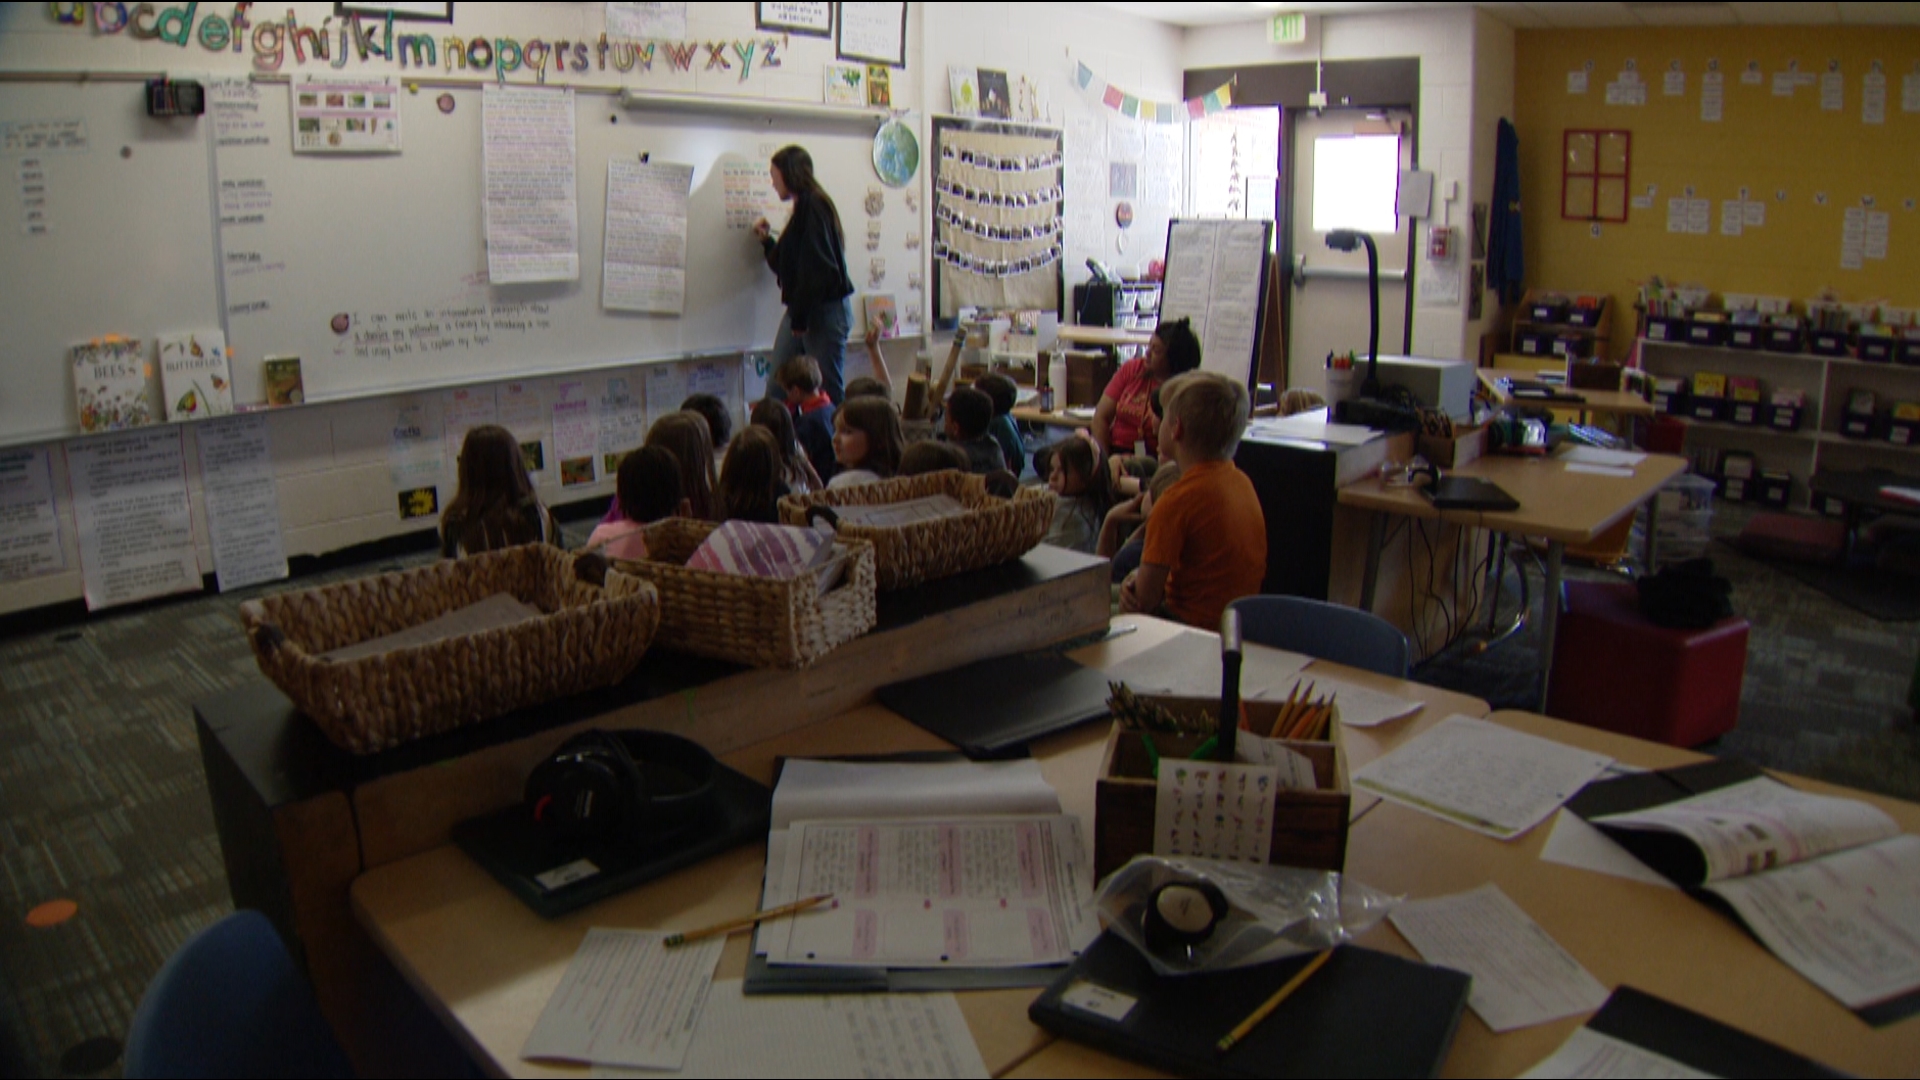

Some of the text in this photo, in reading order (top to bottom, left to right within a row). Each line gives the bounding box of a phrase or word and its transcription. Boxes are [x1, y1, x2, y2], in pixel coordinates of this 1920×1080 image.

[1273, 14, 1302, 40] EXIT
[94, 364, 125, 380] BEES
[166, 358, 222, 372] BUTTERFLIES
